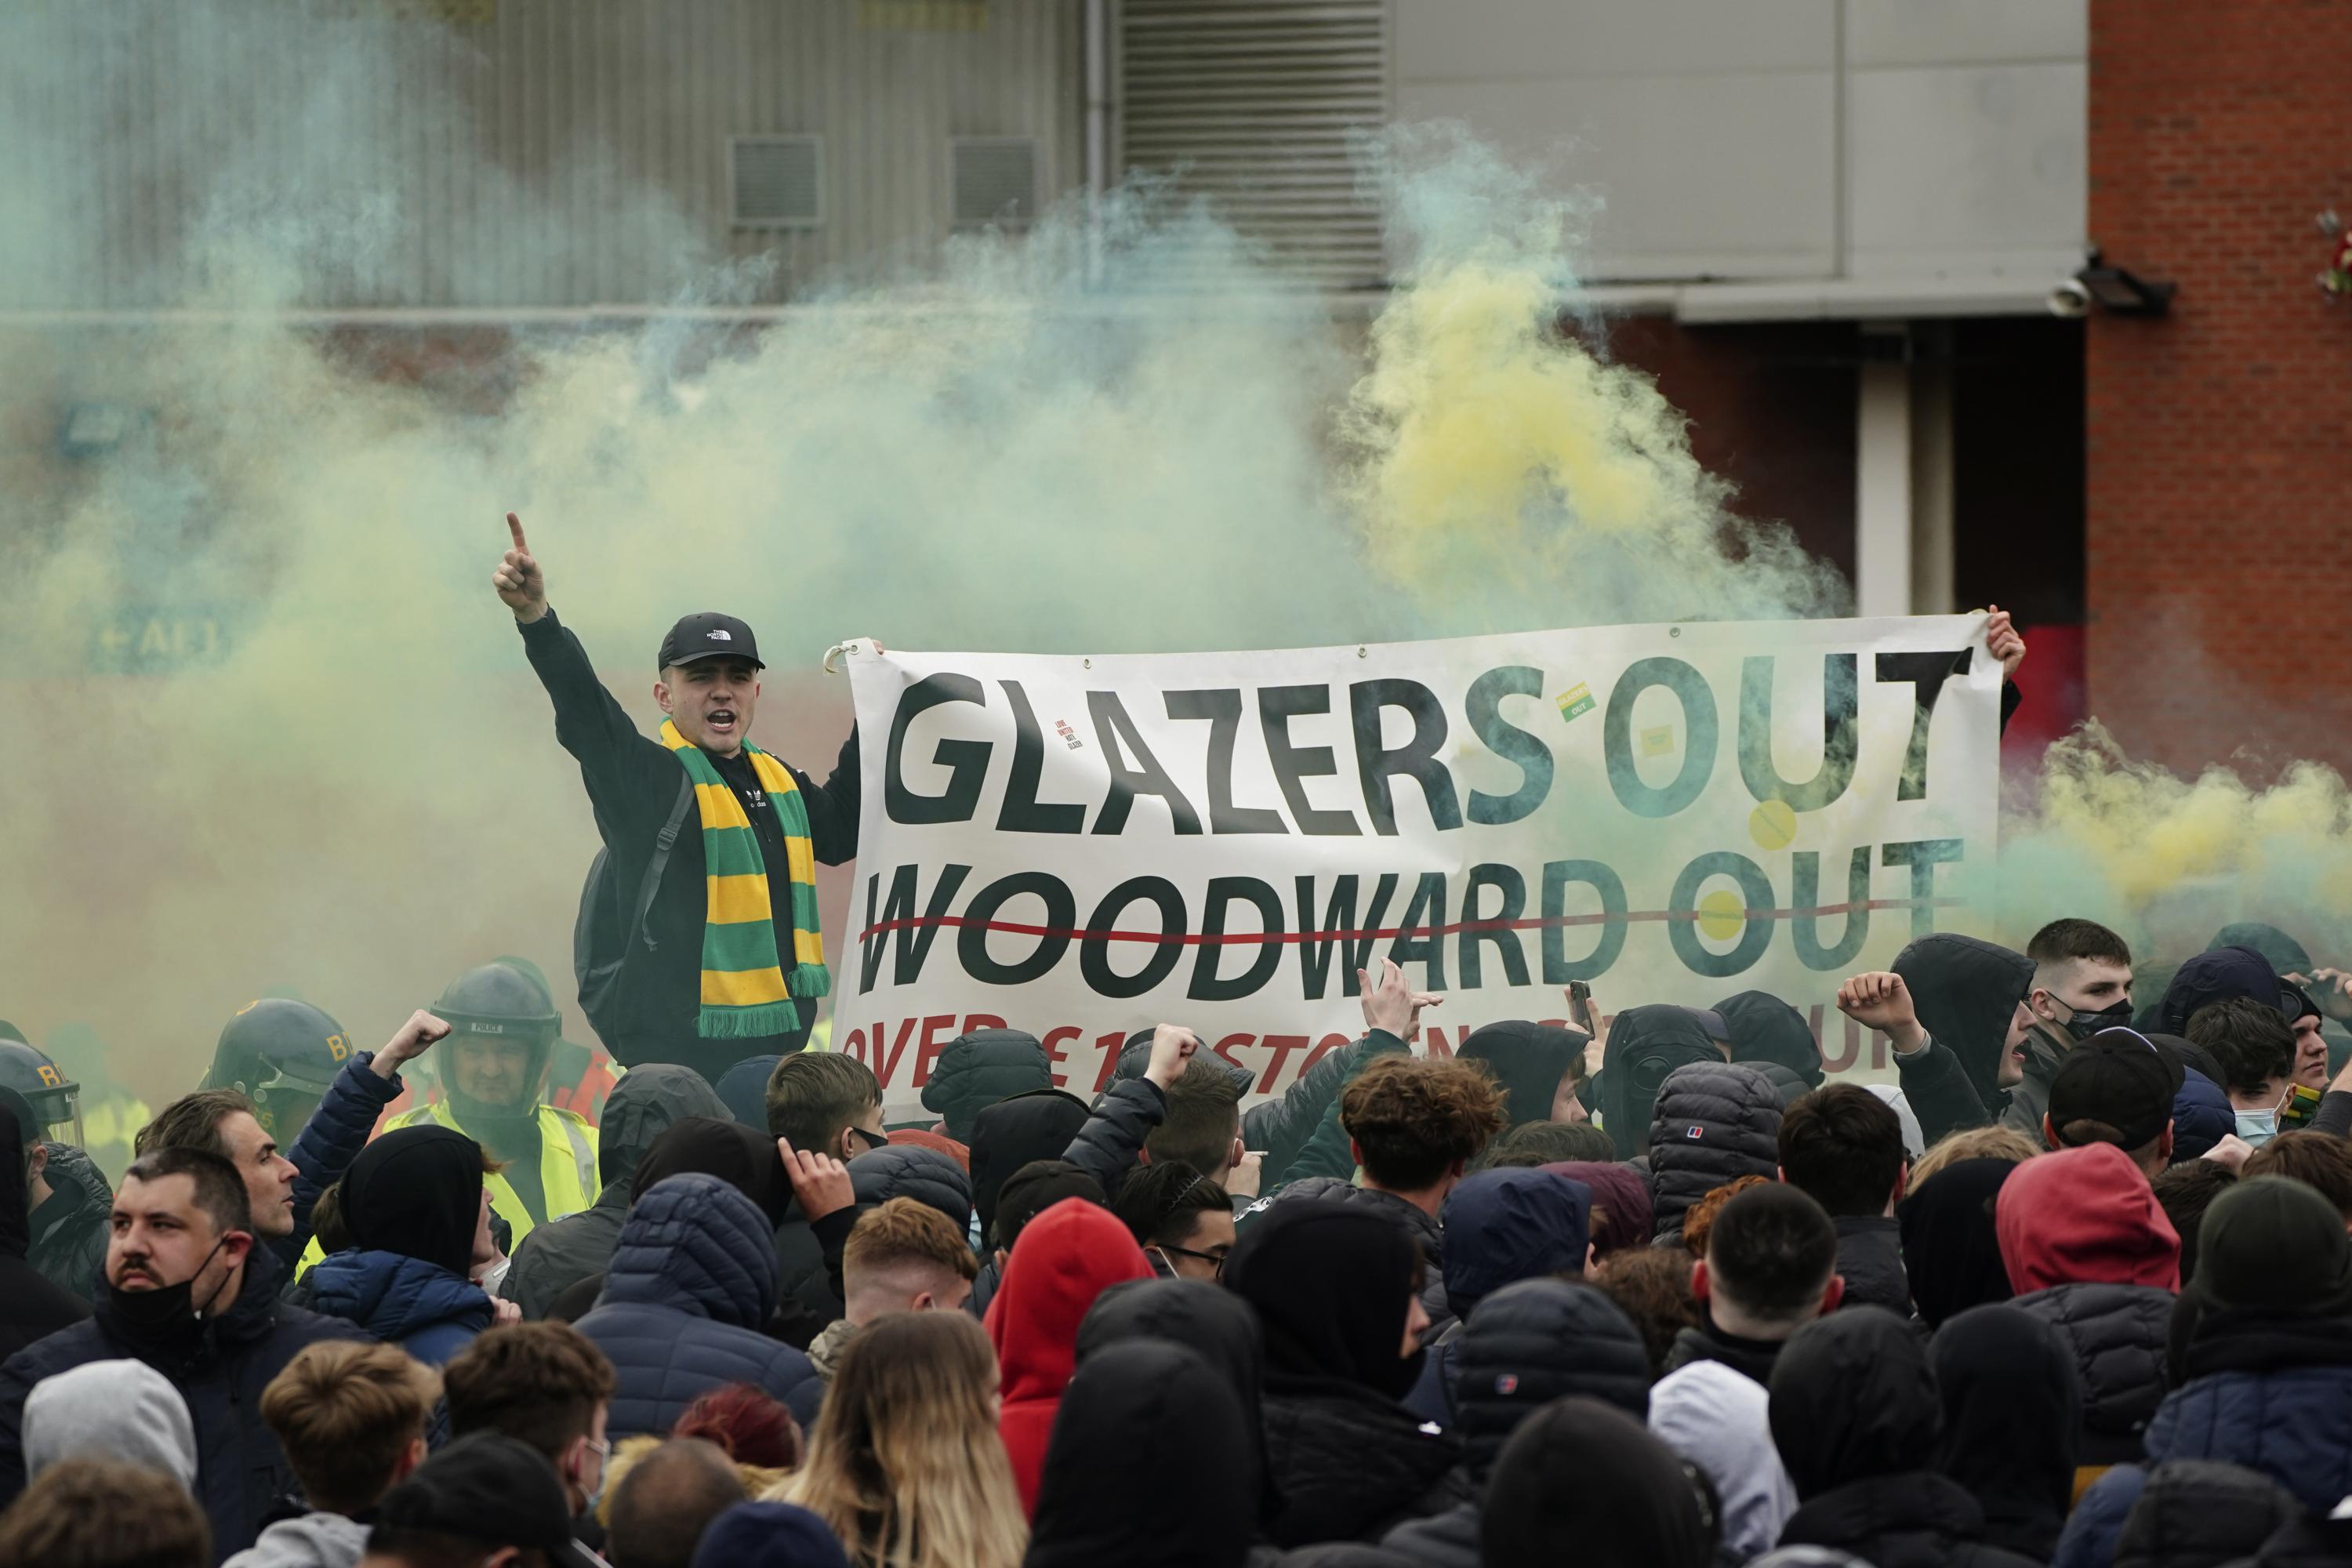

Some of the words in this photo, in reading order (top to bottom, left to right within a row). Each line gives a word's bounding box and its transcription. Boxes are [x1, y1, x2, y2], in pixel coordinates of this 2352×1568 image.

[1571, 702, 1587, 715] OUT
[1054, 720, 1067, 728] LOVE
[1057, 727, 1074, 736] UNITED
[884, 666, 1555, 836] GLAZERS
[1604, 647, 1974, 818] OUT
[859, 859, 1628, 1001] WOODWARD
[1668, 839, 1964, 978] OUT
[475, 1022, 499, 1033] POLICE
